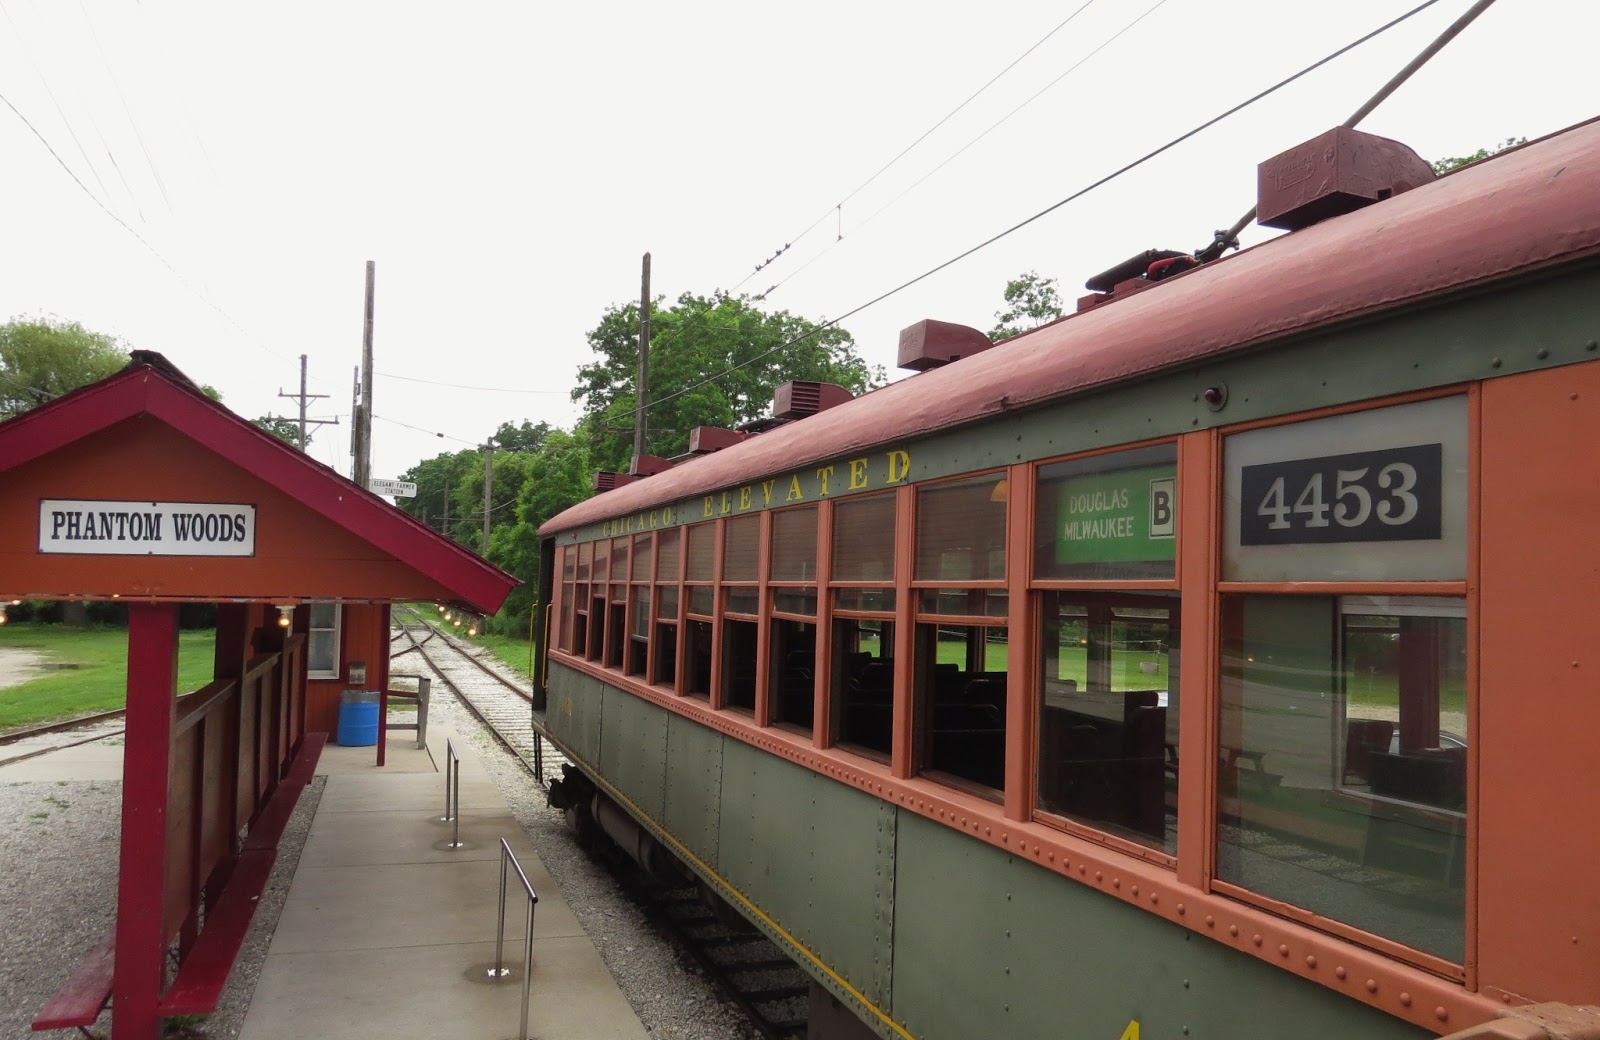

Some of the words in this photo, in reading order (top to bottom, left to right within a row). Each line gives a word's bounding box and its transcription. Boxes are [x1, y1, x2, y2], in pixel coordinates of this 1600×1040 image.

[373, 480, 394, 488] ELEGANT
[396, 482, 415, 490] FARMER
[384, 487, 404, 495] STATION
[603, 507, 671, 536] CHICAGO
[703, 450, 911, 517] ELEVATED
[1257, 462, 1419, 529] 4453
[1070, 488, 1129, 514] DOUGLAS
[1153, 491, 1171, 525] B
[51, 511, 163, 541] PHANTOM
[172, 513, 247, 542] WOODS
[1064, 516, 1134, 541] MILWAUKEE
